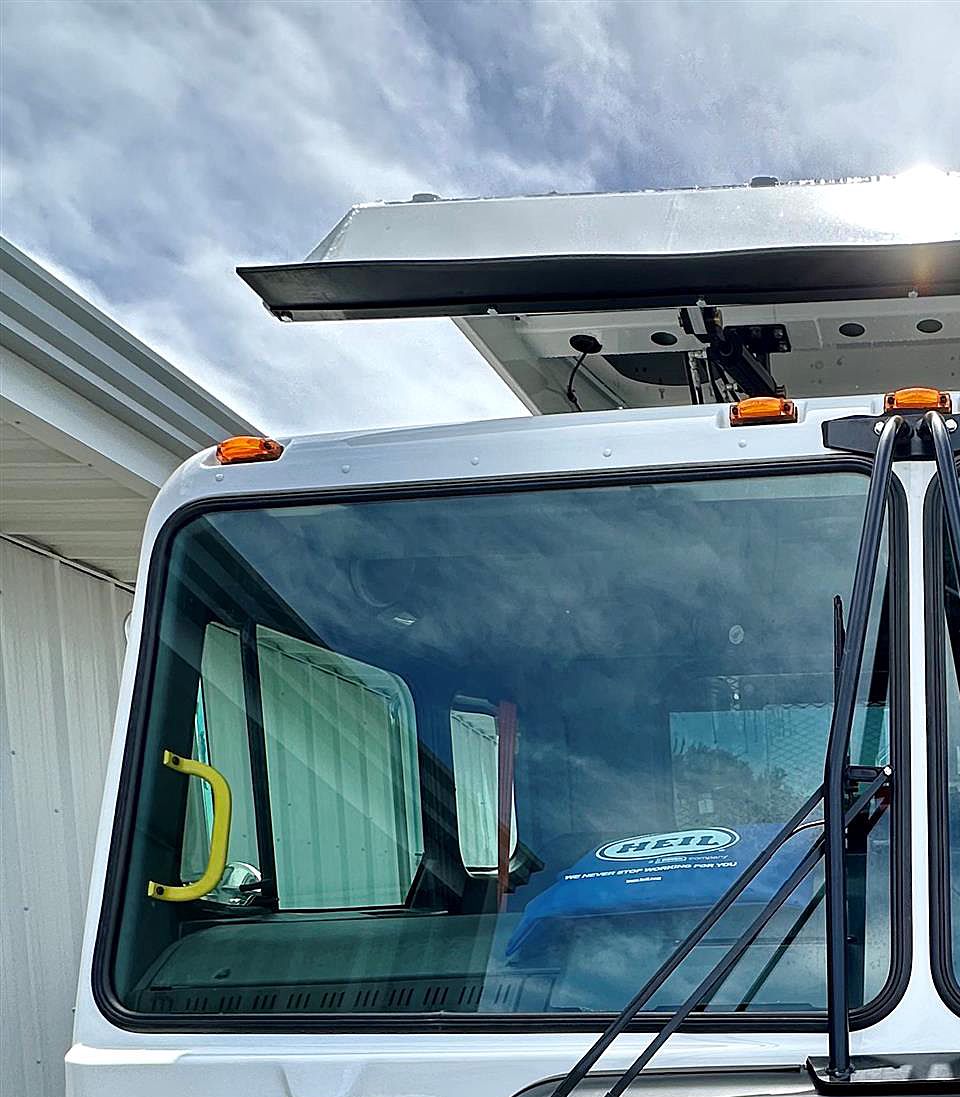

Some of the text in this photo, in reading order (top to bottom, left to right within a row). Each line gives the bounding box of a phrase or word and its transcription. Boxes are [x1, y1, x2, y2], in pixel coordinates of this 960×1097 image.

[616, 835, 719, 854] HEIL
[581, 870, 616, 879] NEVER
[644, 864, 692, 873] WORKING
